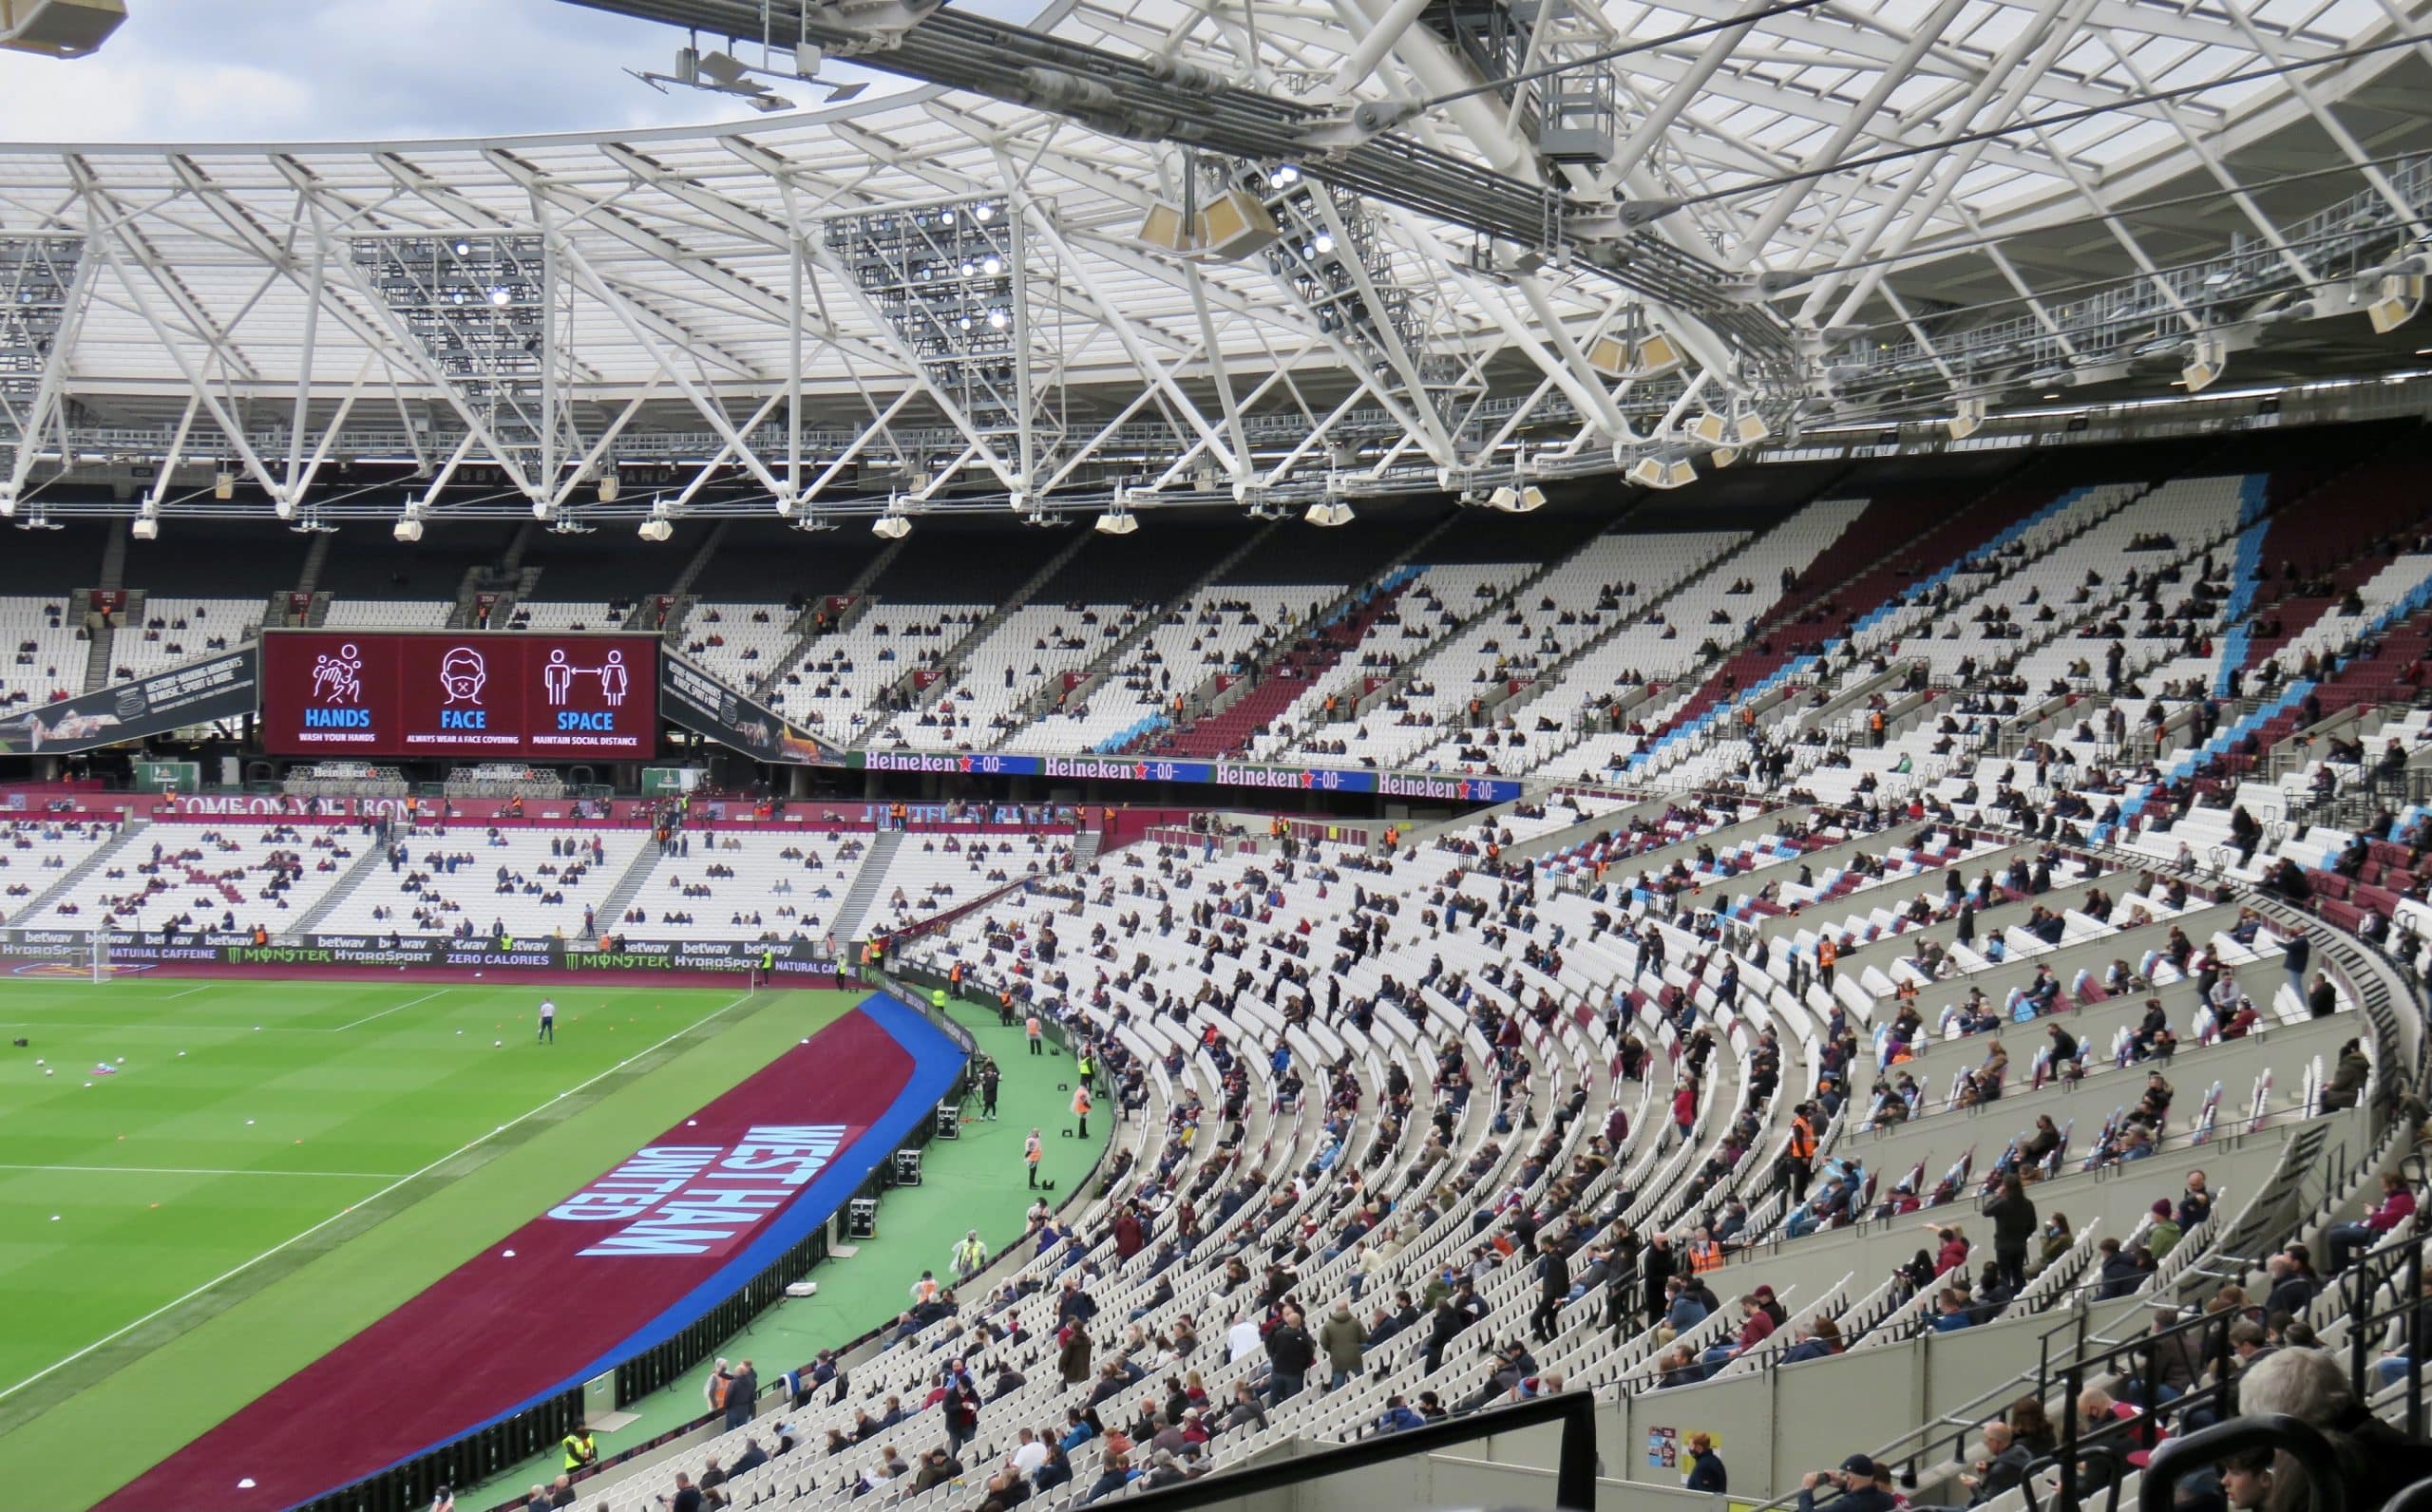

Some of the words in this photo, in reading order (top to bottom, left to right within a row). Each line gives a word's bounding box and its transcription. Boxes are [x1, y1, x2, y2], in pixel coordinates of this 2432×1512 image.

[305, 709, 370, 728] HANDS
[441, 710, 485, 729] FACE
[558, 712, 614, 731] SPACE
[299, 733, 323, 742] WASH
[324, 733, 347, 742] YOUR
[347, 733, 375, 743] HANDS
[482, 736, 520, 745] COVERING
[532, 736, 571, 745] MAINTAIN
[571, 736, 598, 746] SOCIAL
[599, 737, 637, 746] DISTANCE
[864, 751, 956, 772] Heineken
[1045, 757, 1131, 780] Heineken
[1216, 764, 1299, 788] Heineken
[1378, 773, 1455, 799] Heineken
[25, 931, 73, 943] betway
[85, 932, 133, 944] betway
[205, 936, 254, 947] betway
[318, 936, 366, 948] betway
[378, 937, 428, 950] bway
[512, 940, 549, 952] etway
[682, 942, 732, 954] betway
[743, 943, 793, 957] betway
[162, 949, 216, 959] CAFFEINE
[446, 954, 482, 965] ZERO
[484, 954, 549, 966] CALORIES
[674, 954, 761, 970] HYDROSPOR
[774, 961, 819, 973] NATURAL
[705, 1124, 846, 1185] WEST
[547, 1146, 724, 1221] UNITED
[574, 1189, 796, 1257] HAM
